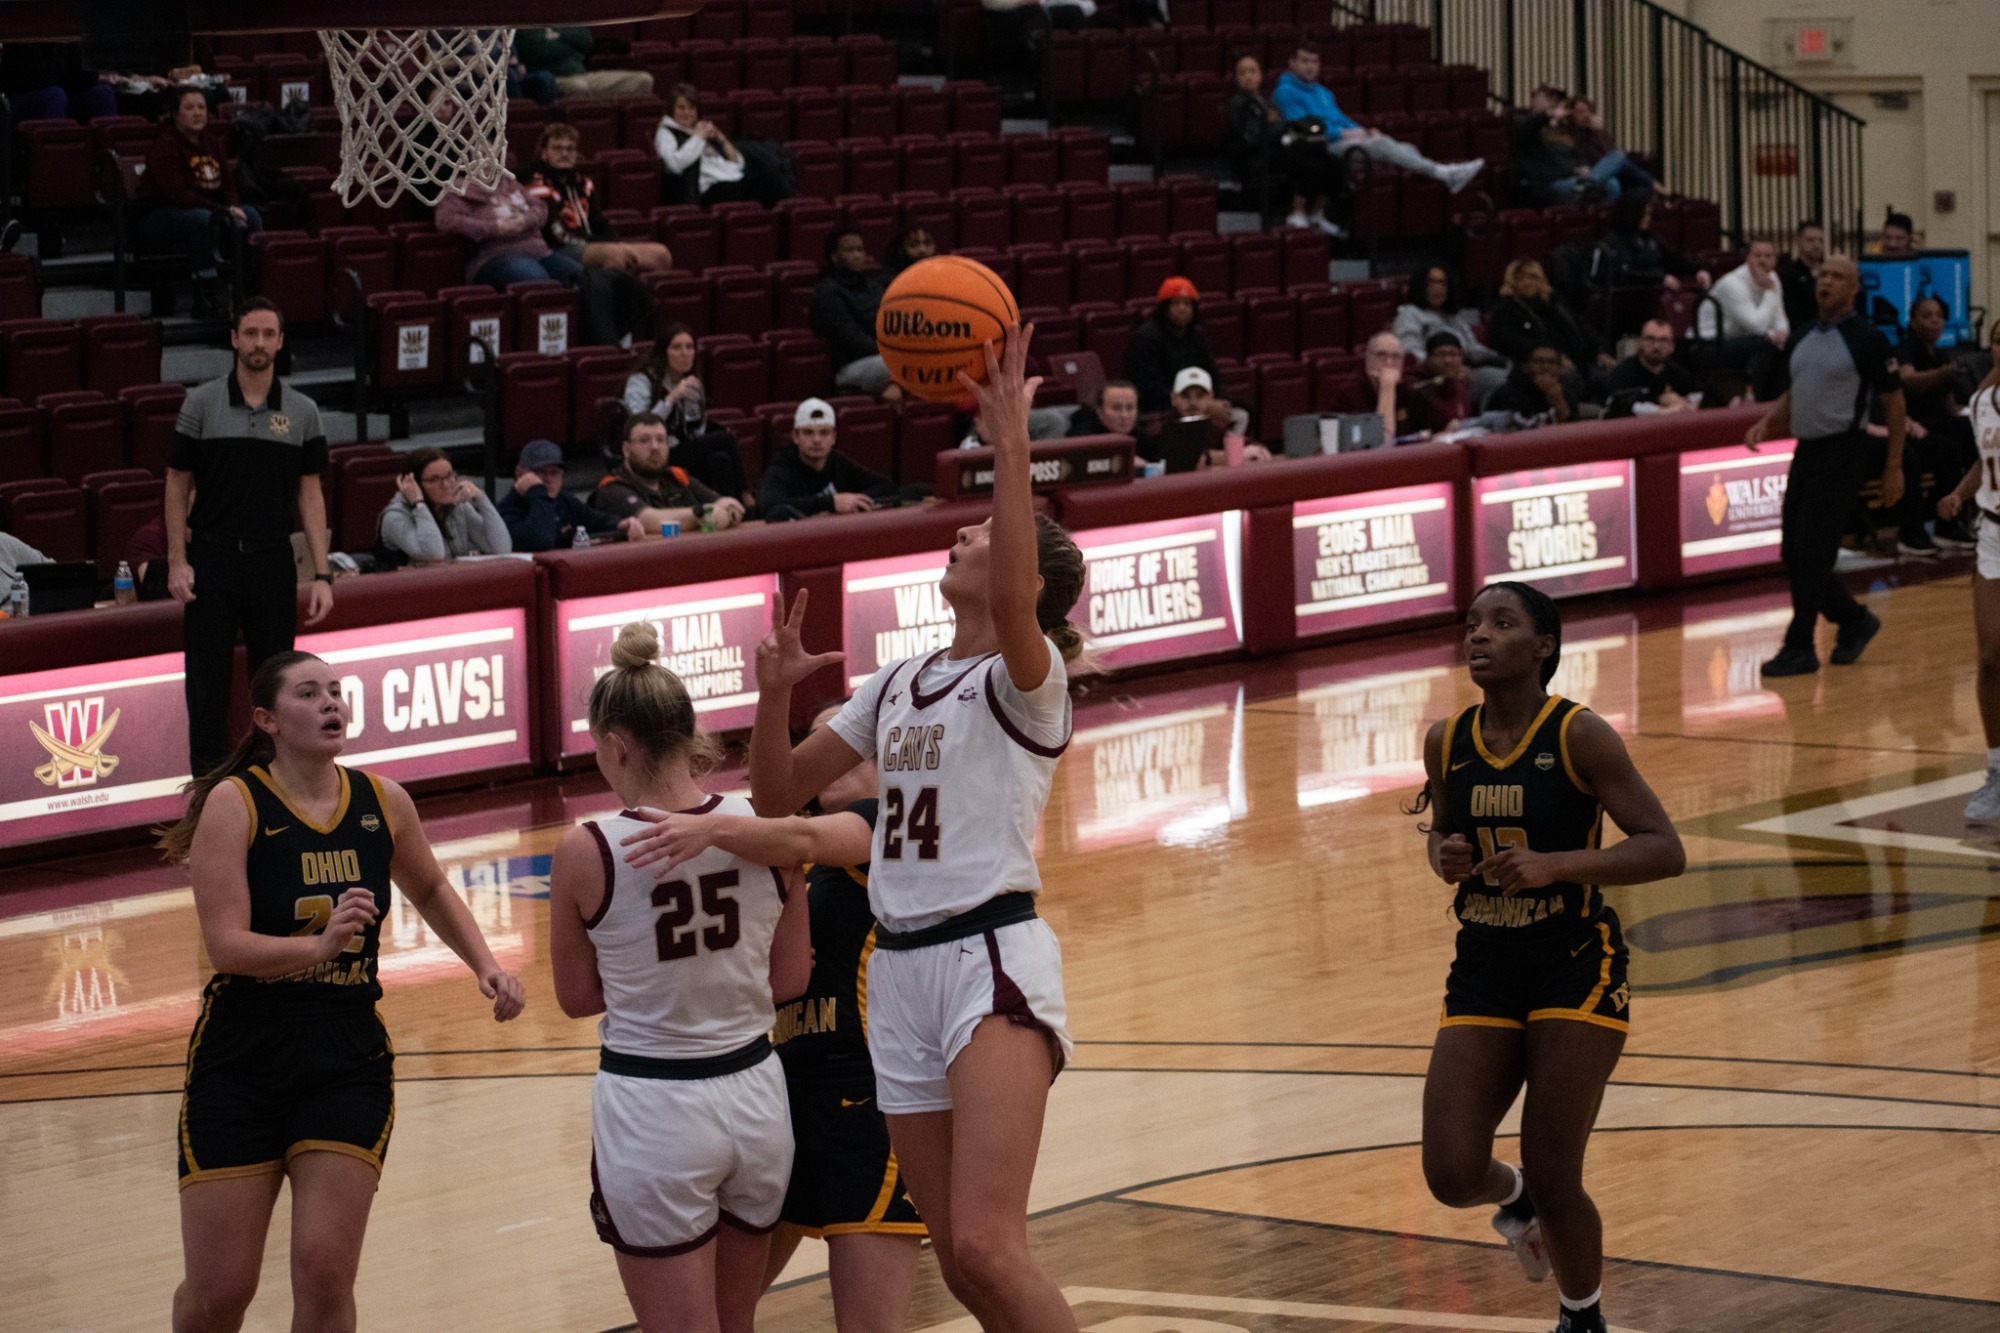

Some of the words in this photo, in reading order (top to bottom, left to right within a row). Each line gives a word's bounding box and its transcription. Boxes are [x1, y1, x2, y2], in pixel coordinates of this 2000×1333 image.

[883, 310, 971, 338] Wilson
[1512, 496, 1554, 530] FEAR
[1554, 491, 1589, 524] THE
[1725, 474, 1788, 506] WALSH
[1317, 520, 1367, 556] 2005
[1370, 513, 1416, 550] NAIA
[1507, 520, 1598, 570] SWORDS
[1090, 555, 1136, 594] HOME
[1138, 551, 1161, 586] OF
[1163, 545, 1198, 582] THE
[894, 581, 956, 628] WAL
[1089, 580, 1203, 635] CAVALIERS
[671, 612, 724, 653] NAIA
[876, 622, 956, 668] UNIVER
[382, 654, 505, 732] CAVS!
[884, 723, 945, 772] CAVS
[48, 791, 110, 811] www.walsh.edu
[882, 784, 942, 862] 24
[1470, 784, 1524, 817] OHIO
[301, 849, 361, 885] OHIO
[290, 894, 366, 954] 2
[650, 868, 741, 963] 25
